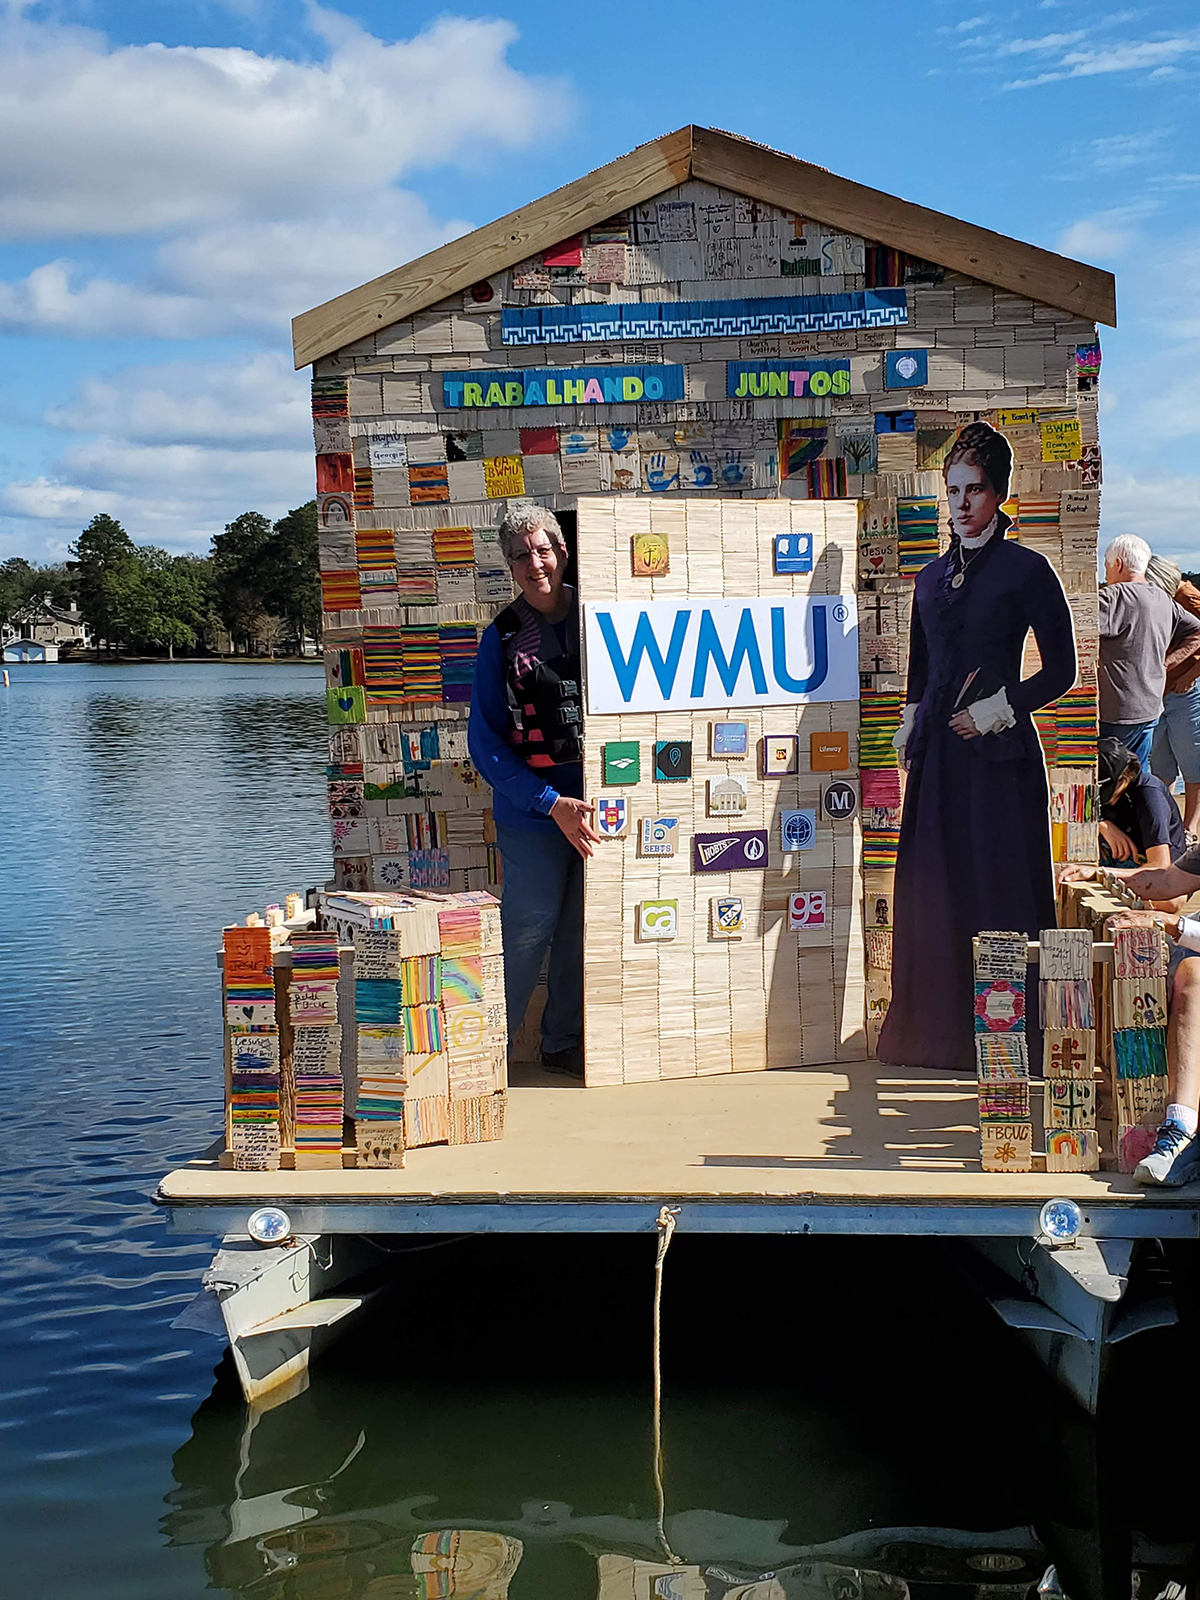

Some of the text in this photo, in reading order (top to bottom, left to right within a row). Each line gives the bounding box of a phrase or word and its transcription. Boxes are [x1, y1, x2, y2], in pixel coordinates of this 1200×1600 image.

[443, 369, 851, 407] TRABALHANDO JUNTOS
[1046, 422, 1080, 434] BWMU
[373, 451, 405, 460] Georgia
[488, 465, 519, 478] BWMU
[644, 550, 662, 570] Joy
[595, 605, 830, 703] WMU
[830, 791, 851, 810] M
[644, 844, 672, 853] SEBTS
[704, 841, 728, 861] NOBTS
